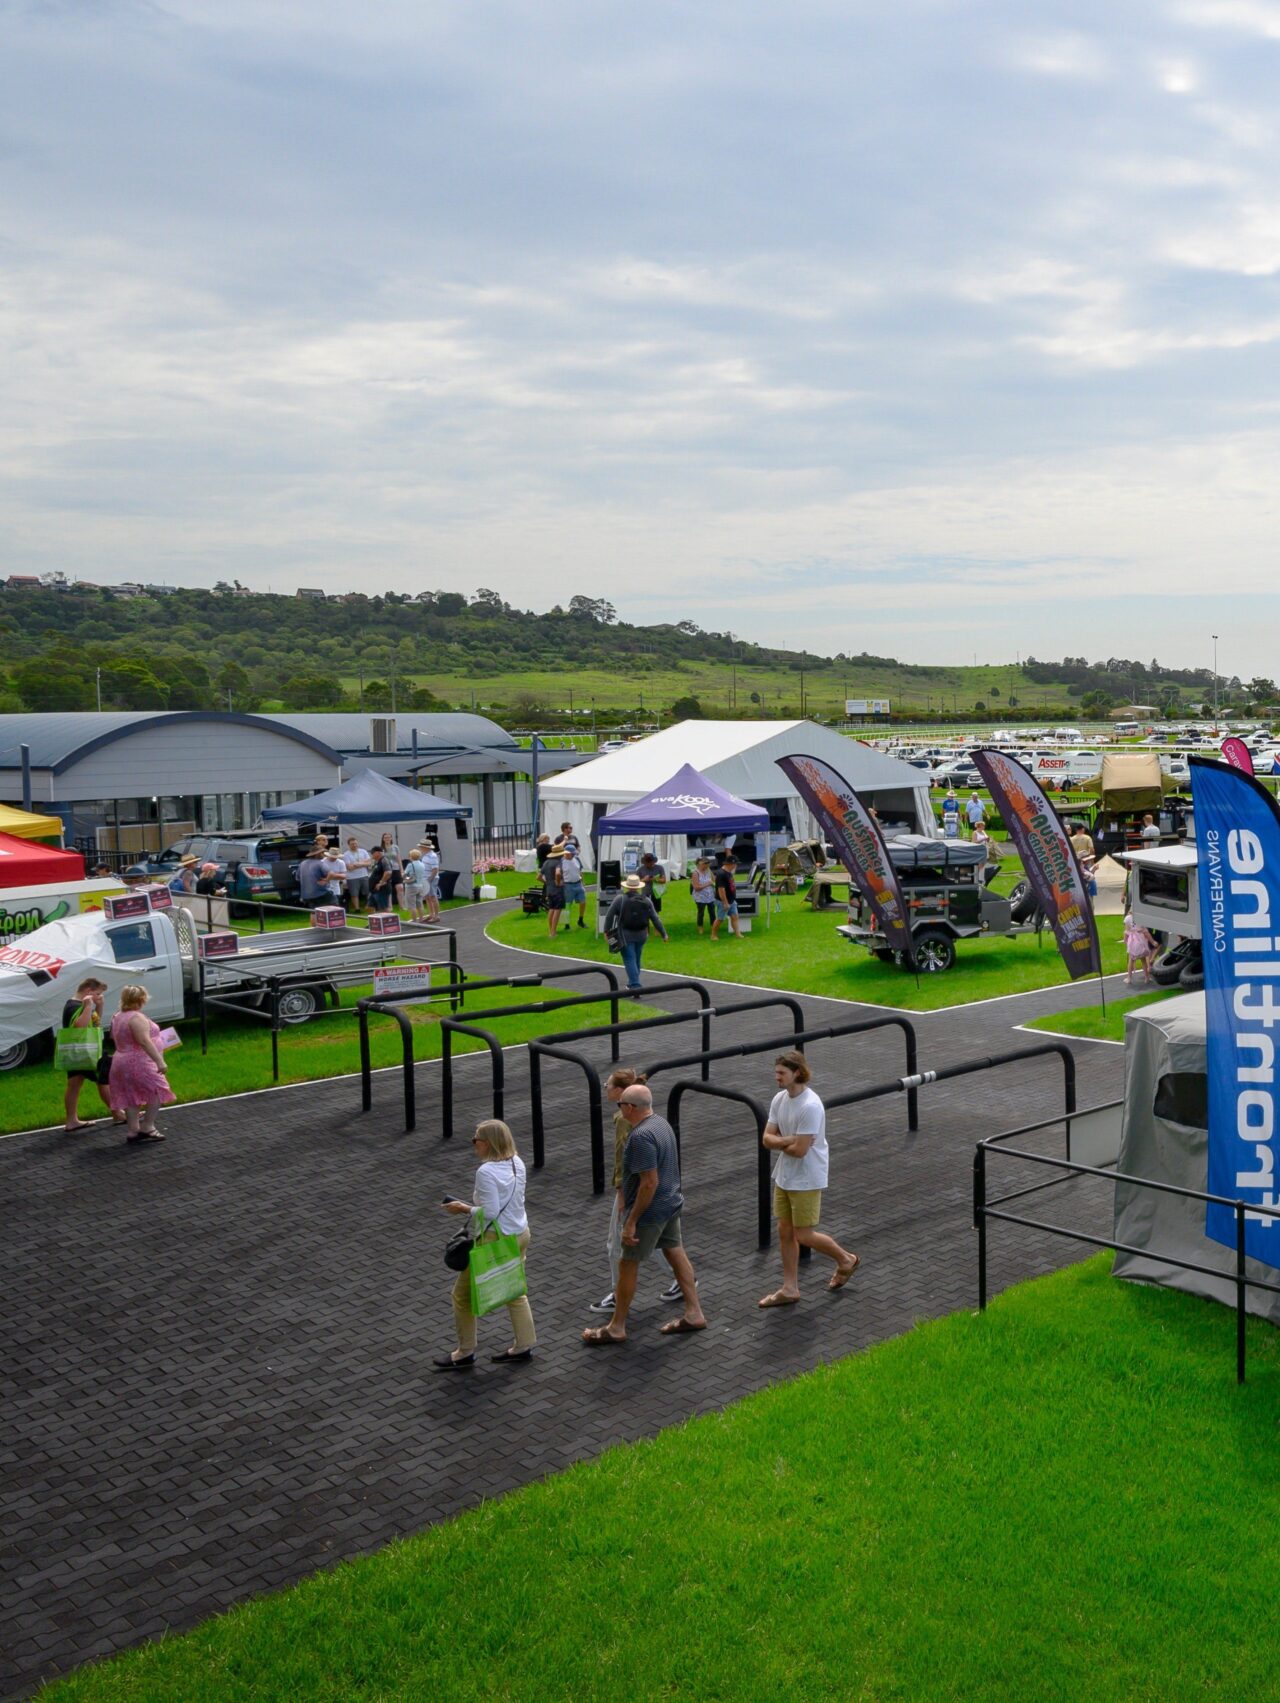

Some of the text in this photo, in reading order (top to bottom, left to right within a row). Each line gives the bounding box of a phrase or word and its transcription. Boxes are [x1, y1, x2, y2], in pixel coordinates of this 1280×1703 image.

[841, 825, 873, 873] CAMPERS
[843, 810, 887, 878] AUSTRACK
[1028, 832, 1058, 885] CAMPERS
[1030, 813, 1076, 895] AUSTRACK
[378, 973, 426, 983] HORSE HAZARD
[387, 967, 419, 976] WARNING
